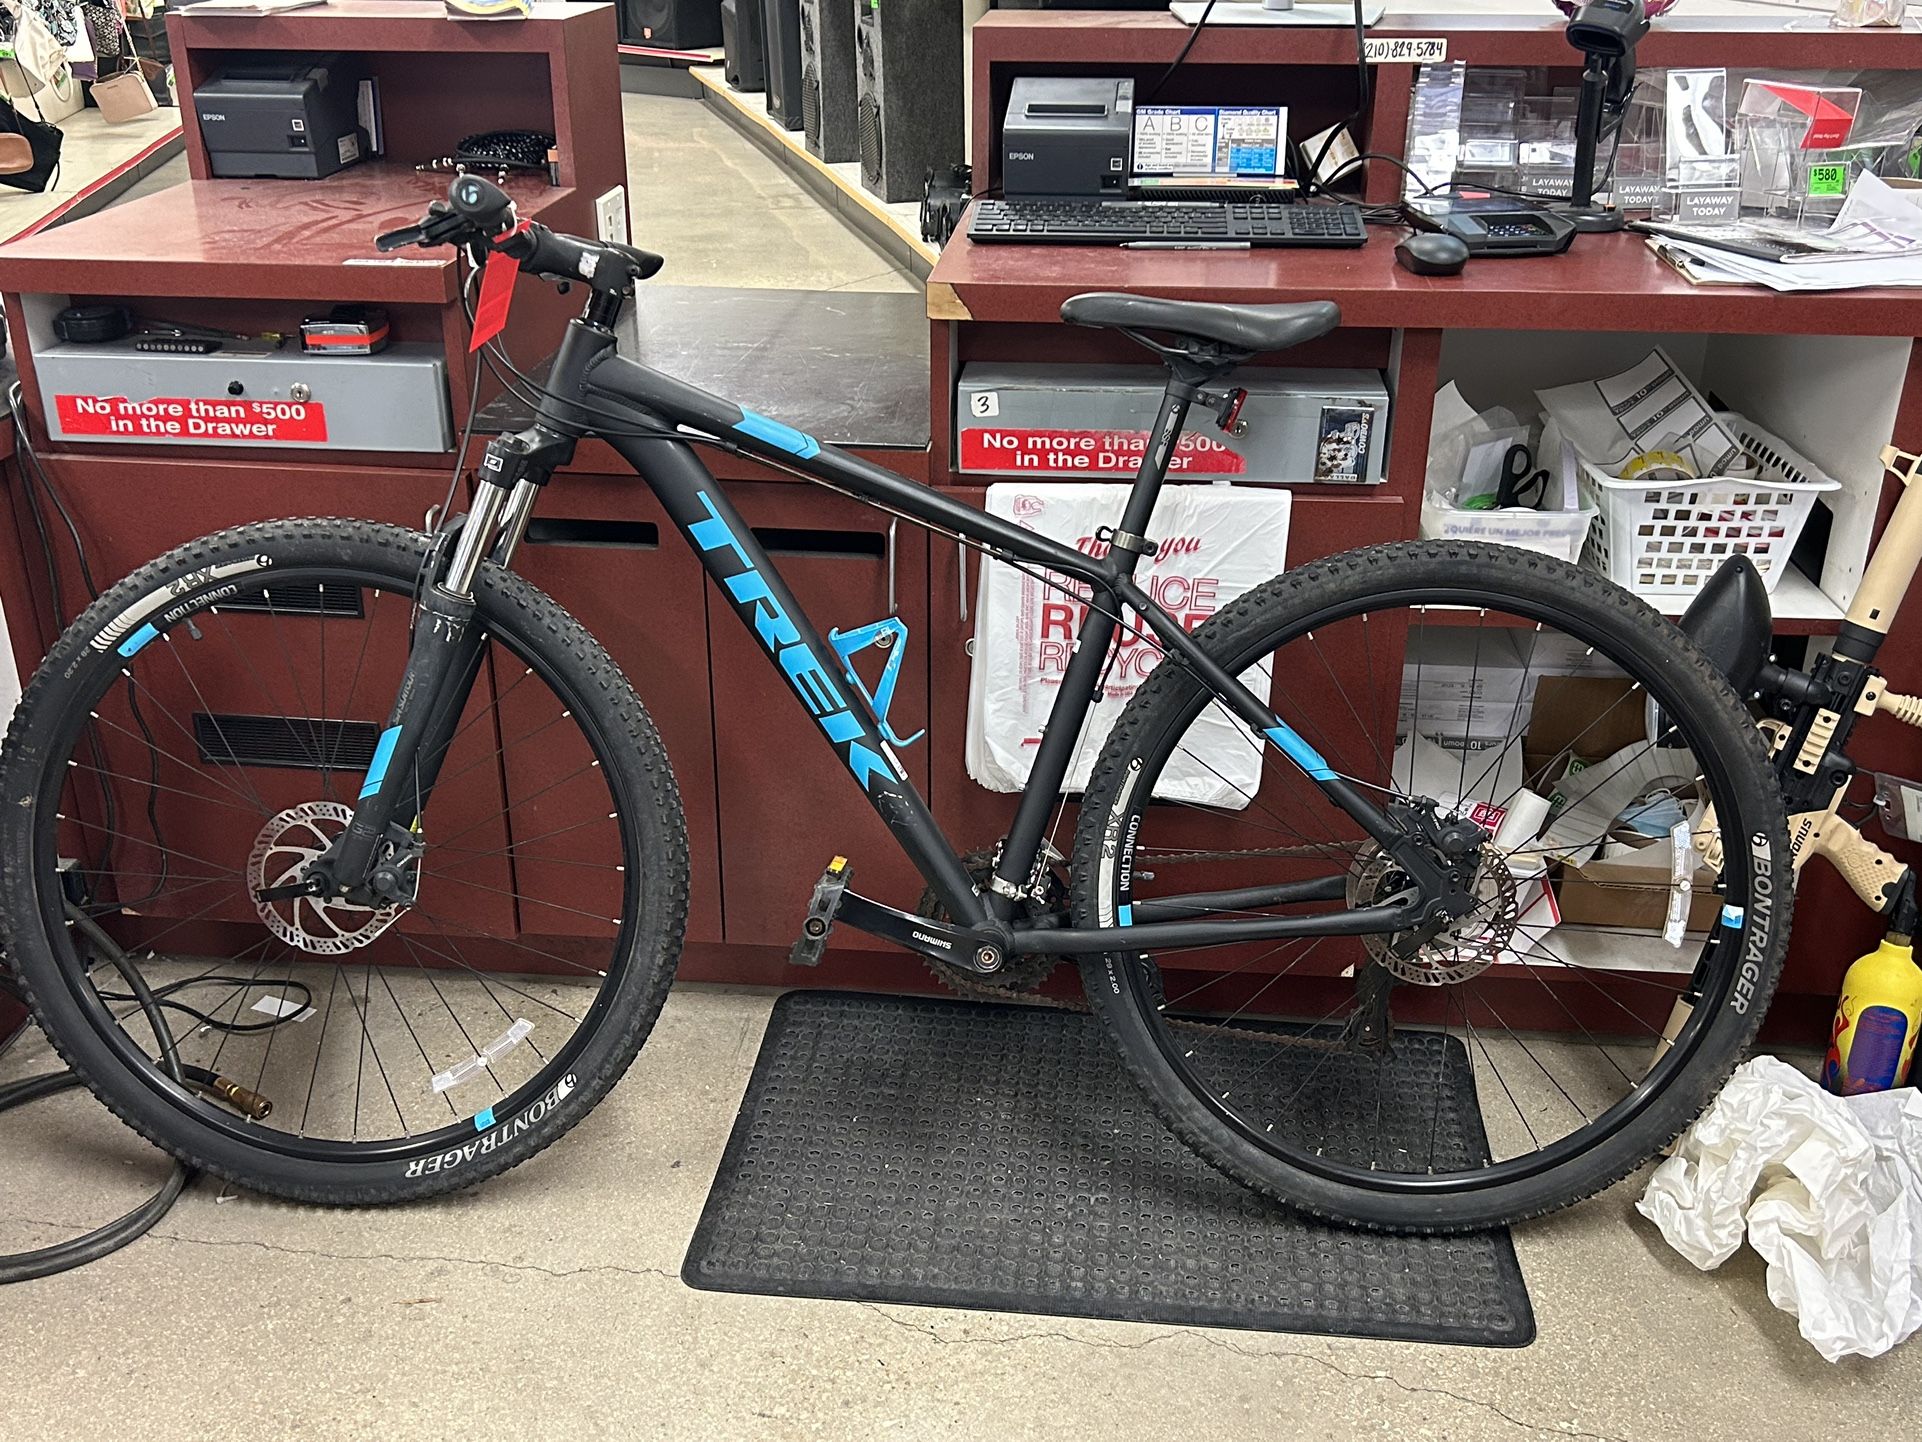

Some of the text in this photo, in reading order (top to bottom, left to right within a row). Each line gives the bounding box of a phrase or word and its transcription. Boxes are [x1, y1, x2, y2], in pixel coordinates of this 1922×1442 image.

[203, 113, 226, 121] EPSON
[1143, 116, 1155, 131] A
[1170, 116, 1182, 131] B
[1195, 116, 1208, 132] C
[1009, 152, 1034, 160] EPSON
[1532, 178, 1574, 187] LAYAWAY
[1813, 168, 1837, 181] $580
[1538, 188, 1567, 197] TODAY
[1619, 185, 1662, 194] LAYAWAY
[1624, 195, 1653, 204] TODAY
[1686, 196, 1733, 205] LAYAWAY
[1692, 207, 1726, 216] TODAY
[76, 398, 306, 420] No more than $500
[977, 397, 990, 413] 3
[110, 416, 277, 437] in the Drawer
[1358, 412, 1370, 454] COWBOYS
[983, 432, 1226, 452] No more tha 500
[1015, 451, 1193, 468] in the Draer
[1154, 537, 1201, 564] you
[164, 584, 239, 623] CONNECTION
[687, 490, 899, 792] TREK
[1791, 818, 1813, 859] onus
[1119, 814, 1141, 892] CONNECTION
[912, 931, 953, 950] SHIMANO
[1730, 856, 1773, 1015] BONTRAGER
[404, 1088, 561, 1179] BONTRAGER
